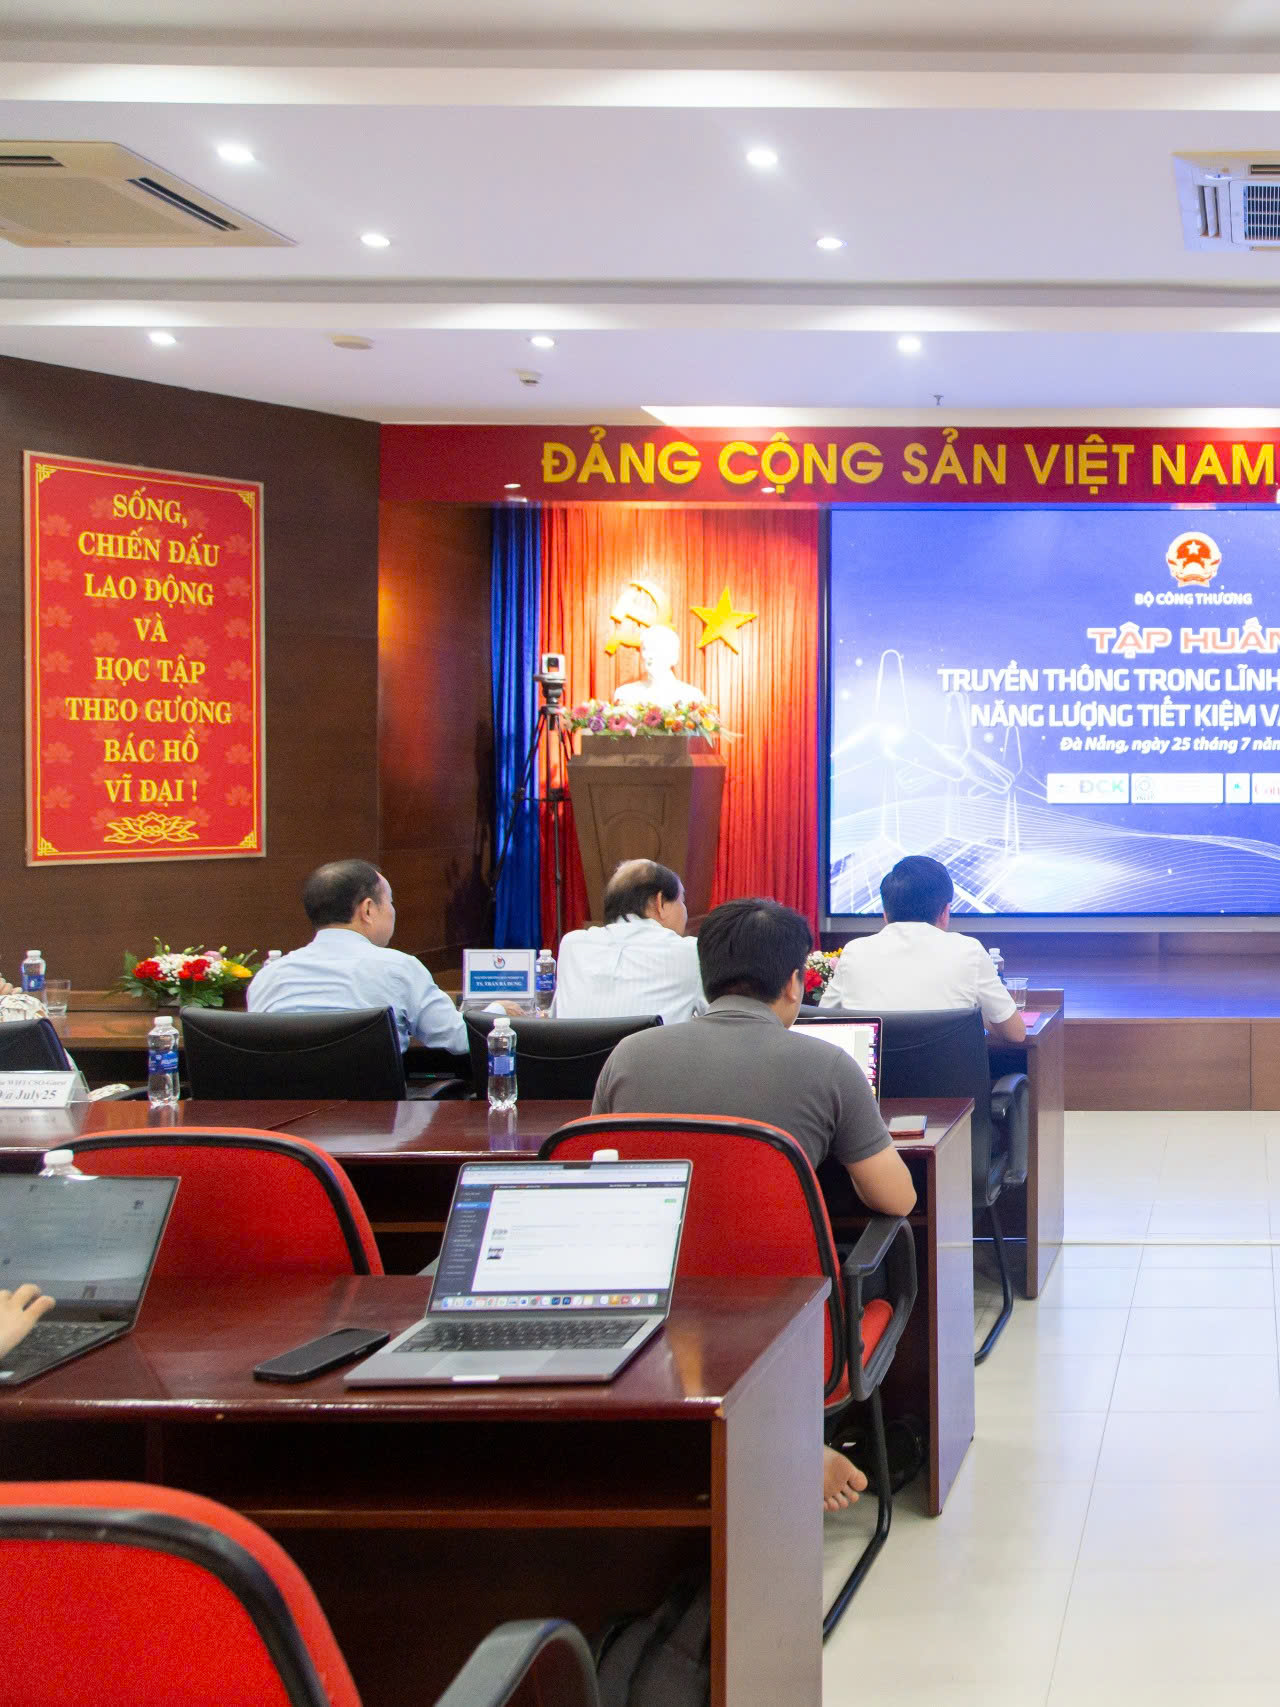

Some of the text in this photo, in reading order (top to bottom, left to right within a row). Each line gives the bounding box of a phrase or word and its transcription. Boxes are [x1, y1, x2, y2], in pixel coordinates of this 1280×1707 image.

[542, 427, 700, 484] ĐẢNG
[718, 431, 883, 494] CỘNG
[903, 426, 1005, 483] SẢN
[1025, 435, 1134, 493] VIỆT
[1153, 440, 1274, 484] NAM
[113, 487, 188, 527] SỐNG,
[78, 528, 219, 566] CHIẾN ĐẤU
[85, 573, 214, 608] LAO ĐỘNG
[1135, 588, 1252, 607] BỘ CÔNG THƯƠNG
[134, 613, 168, 642] VÀ
[1087, 622, 1172, 658] TẬP
[96, 654, 205, 686] HỌC TẬP
[937, 660, 1038, 692] TRUYỀN
[1043, 664, 1129, 691] THÔNG
[1134, 669, 1220, 691] TRONG
[65, 696, 232, 723] THEO GƯƠNG
[970, 699, 1044, 727] NĂNG
[1049, 701, 1133, 731] LƯỢNG
[1137, 696, 1189, 726] TIẾT
[1197, 699, 1256, 730] KIỆM
[104, 728, 198, 762] BÁC HỒ
[1060, 737, 1082, 750] Đà
[1132, 737, 1170, 753] ngày
[1172, 737, 1191, 750] 25
[1194, 737, 1238, 753] tháng
[1241, 737, 1249, 750] 7
[104, 774, 132, 802] VĨ
[140, 779, 184, 807] ĐẠI
